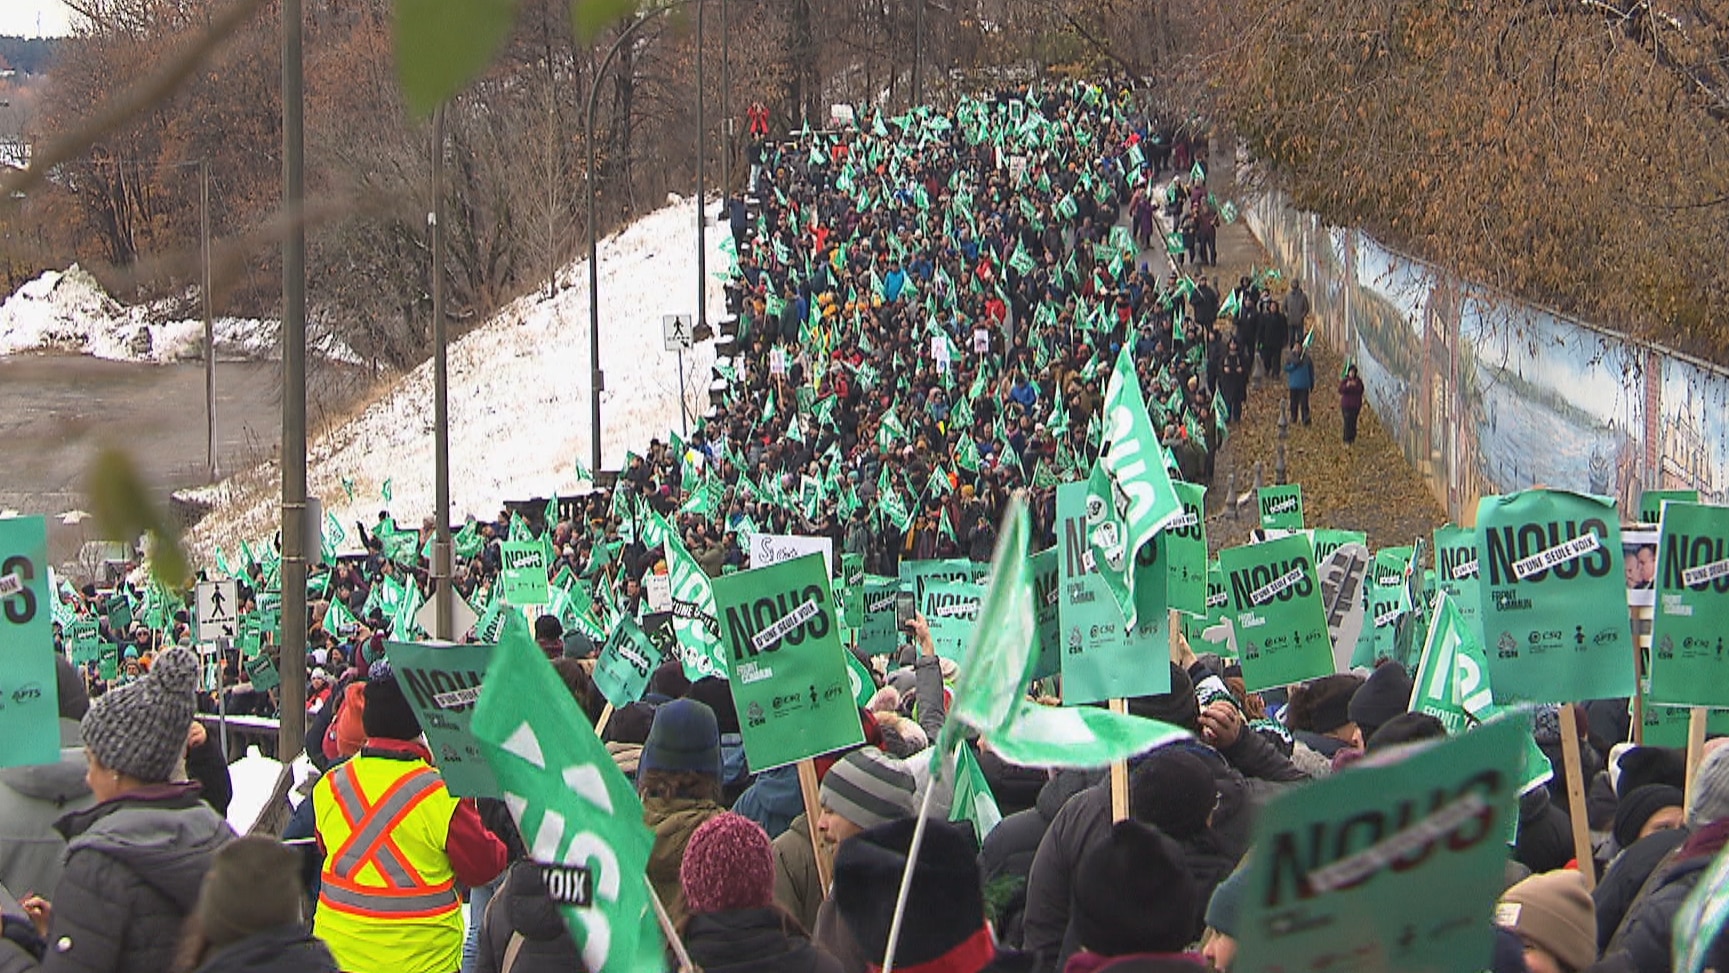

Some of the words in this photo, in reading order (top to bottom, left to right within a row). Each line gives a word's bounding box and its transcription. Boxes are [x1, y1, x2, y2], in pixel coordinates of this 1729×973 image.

[1262, 494, 1299, 515] NOUS
[505, 550, 543, 570] NOUS
[1486, 518, 1612, 586] NOUS
[1516, 559, 1543, 575] D'UNE
[1546, 546, 1573, 564] SEULE
[1574, 535, 1595, 551] VOIX
[1663, 533, 1729, 594] NOU
[1230, 556, 1313, 612] NOUS
[1492, 589, 1517, 602] FRONT
[725, 584, 830, 661] NOUS
[754, 622, 778, 648] D'UNE
[776, 610, 801, 633] SEULE
[798, 600, 818, 618] VOIX
[1542, 630, 1563, 641] CSQ
[612, 626, 653, 679] NOUS
[1498, 649, 1519, 659] CSN
[402, 667, 485, 713] NOU
[748, 717, 766, 728] CSN
[1422, 704, 1461, 730] FRONT
[1262, 768, 1507, 908] NOUS
[543, 866, 586, 905] OIX
